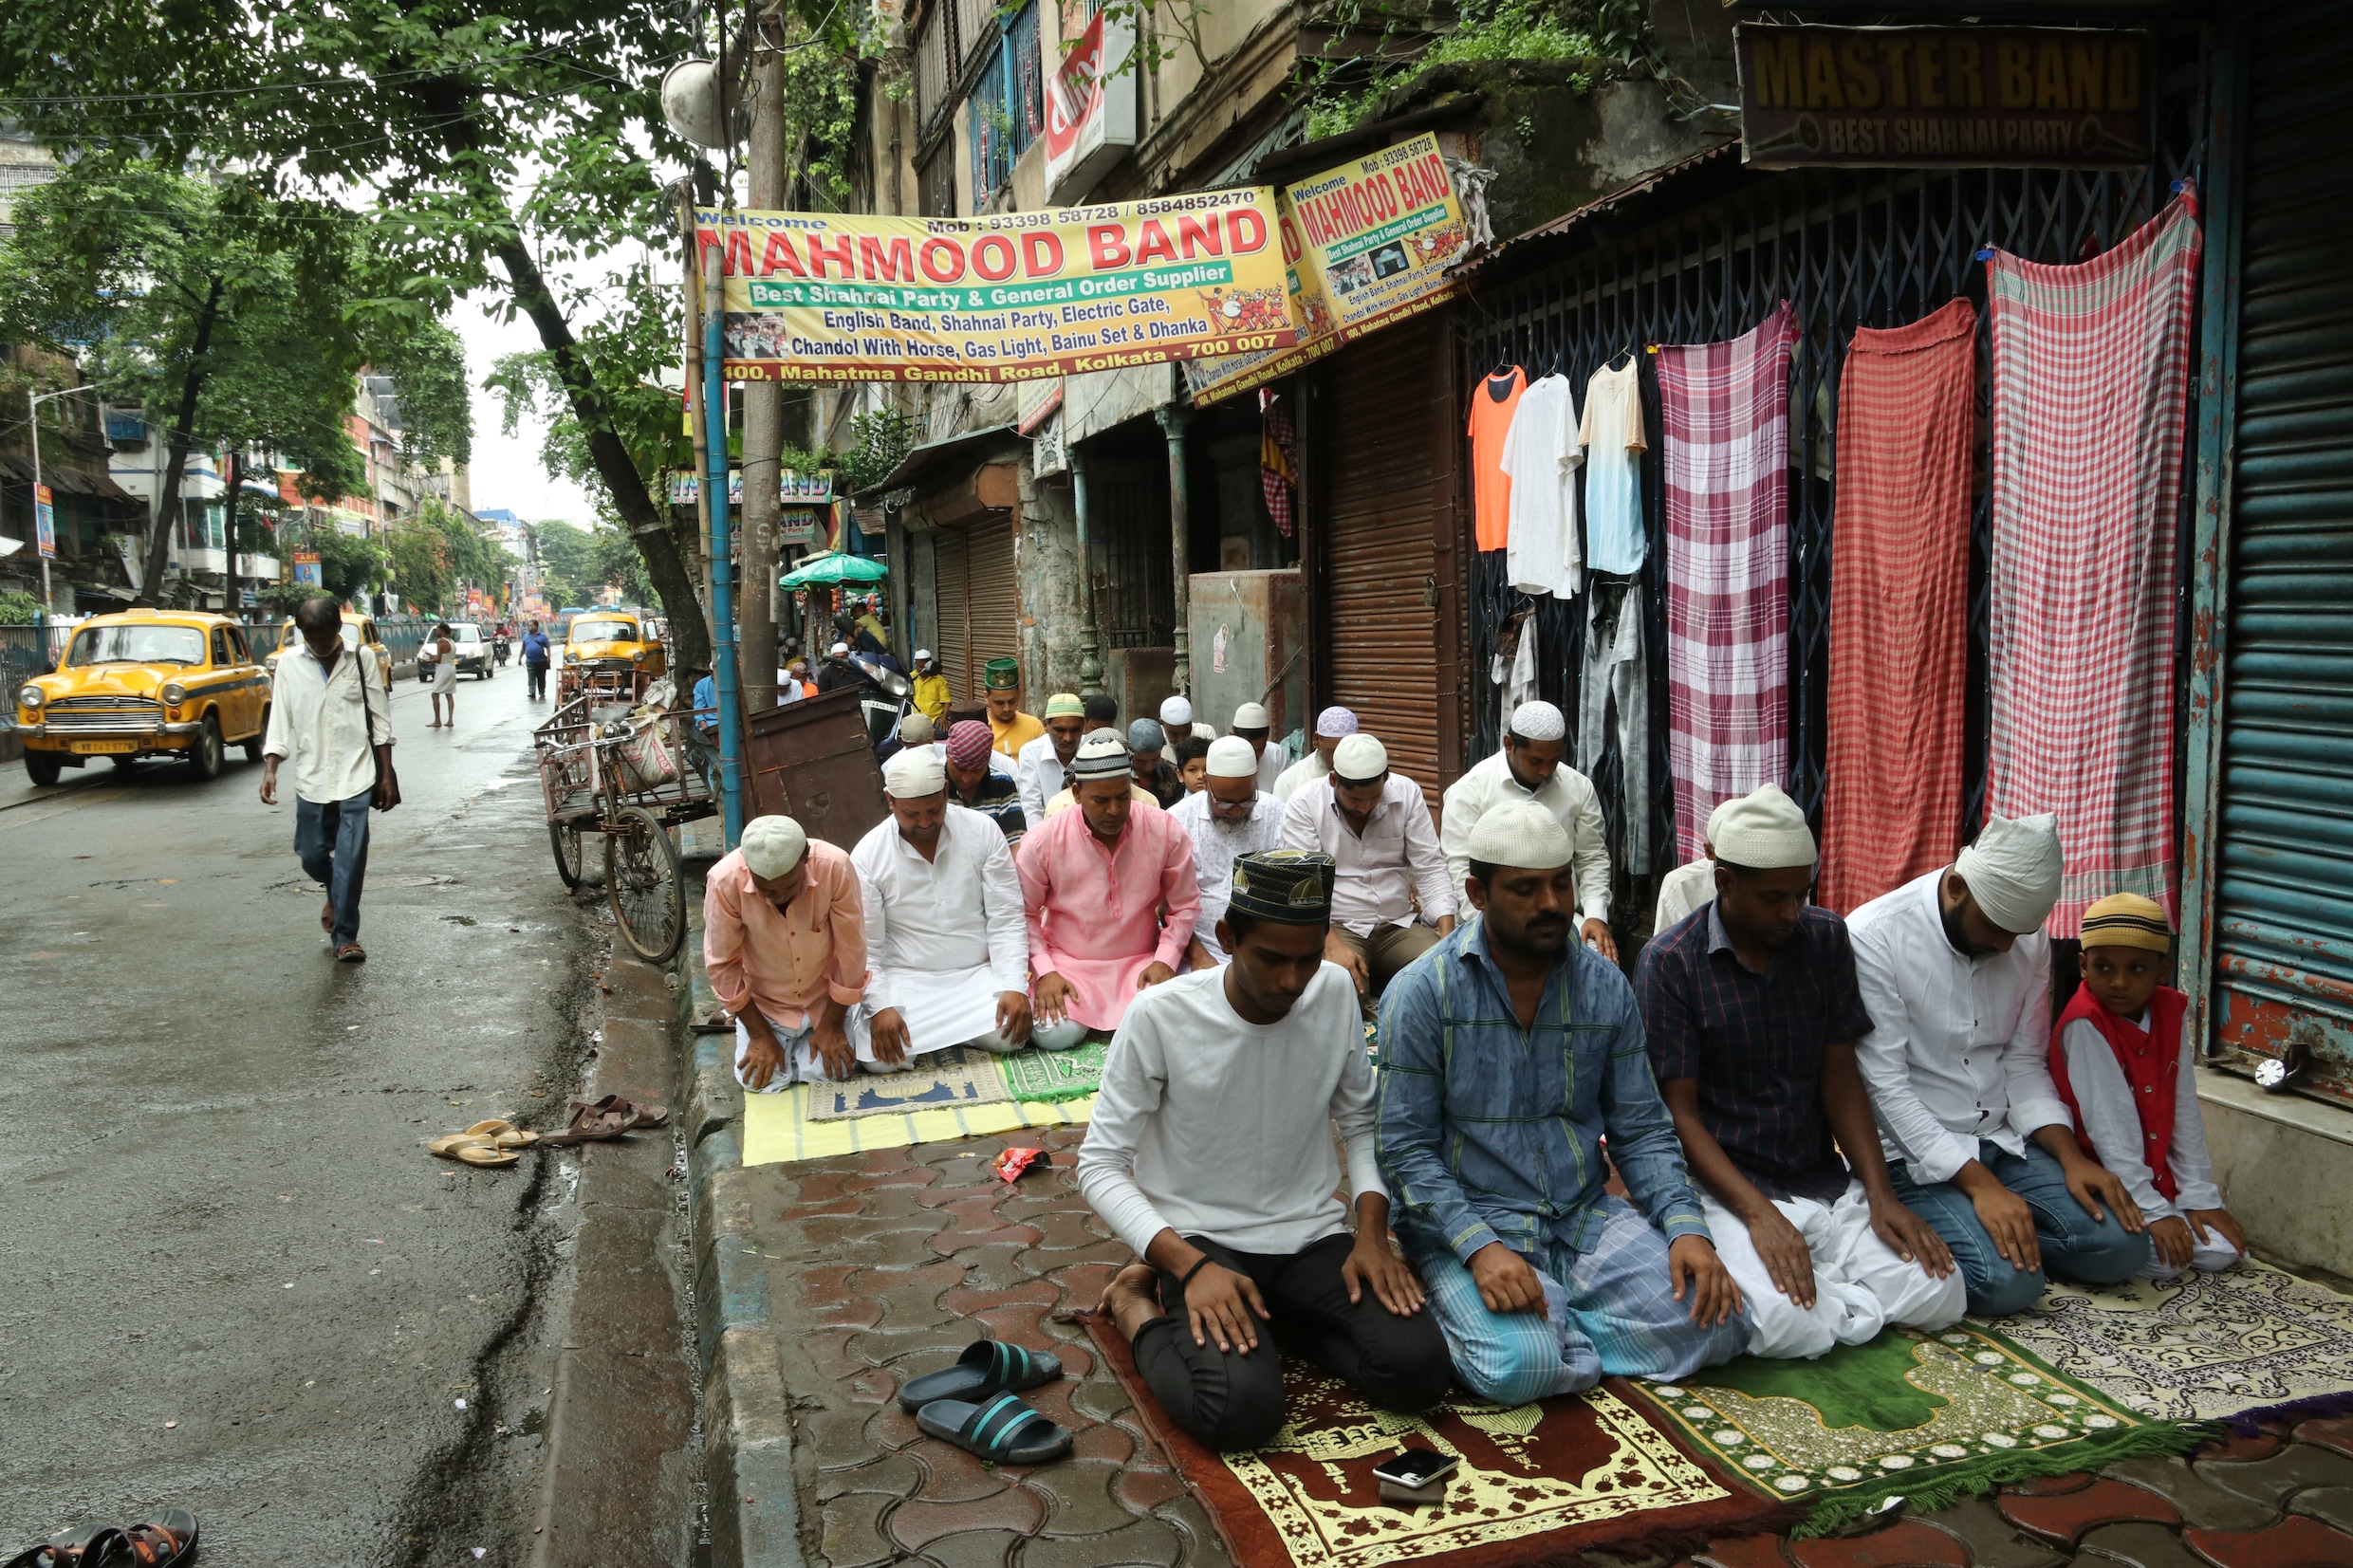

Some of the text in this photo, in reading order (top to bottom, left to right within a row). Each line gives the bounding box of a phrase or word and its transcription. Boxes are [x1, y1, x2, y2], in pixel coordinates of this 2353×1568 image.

[1752, 34, 2141, 111] MASTER BAND
[1361, 157, 1380, 175] Mob
[1383, 145, 1409, 167] 93398
[1408, 137, 1434, 157] 58728
[1827, 118, 2074, 156] BEST SHAHNAI PARTY
[1292, 175, 1347, 202] Welcome
[1297, 173, 1399, 249] MAHMOOD
[1392, 153, 1451, 212] BAND
[694, 212, 828, 230] Welcome
[927, 220, 971, 234] Mob
[990, 213, 1051, 231] 93398
[1057, 206, 1119, 223] 58728
[1125, 205, 1131, 217] /
[1137, 191, 1255, 215] 8584852470
[1326, 207, 1446, 260] Best Shahnai Party & General Order Supplier
[695, 229, 1065, 284] MAHMOOD
[1086, 207, 1269, 271] BAND
[752, 264, 1227, 311] Best Shahnai Party & General Order Supplier
[1347, 288, 1370, 305] English
[1369, 286, 1387, 298] Band,
[1385, 275, 1408, 290] Shahnai
[1408, 268, 1425, 283] Party,
[1424, 260, 1447, 275] Electric
[824, 296, 1171, 334] English Band, Shahnai Party, Electric Gate,
[1343, 305, 1366, 323] Chandol
[1365, 302, 1380, 315] With
[1397, 291, 1409, 302] Gas
[1346, 326, 1362, 340] 100,
[1360, 316, 1390, 334] Mahatma
[1389, 305, 1413, 322] Gandhi
[1411, 300, 1432, 314] Road,
[1430, 289, 1455, 306] Kolkata
[791, 317, 1208, 361] Chandol With Horse, Gas Light, Bainu Set & Dhanka
[1295, 323, 1308, 341] anka
[723, 365, 772, 381] 100,
[780, 365, 897, 381] Mahatma
[903, 366, 991, 382] Gandhi
[998, 361, 1068, 381] Road,
[1075, 348, 1166, 373] Kolkata
[1186, 340, 1230, 358] 700
[1235, 335, 1278, 350] 007
[1210, 384, 1237, 402] Mahatma
[1236, 374, 1259, 390] Gandhi
[1275, 353, 1304, 374] Kolkata
[1306, 344, 1321, 360] 700
[1320, 337, 1335, 353] 007
[780, 470, 830, 496] AND
